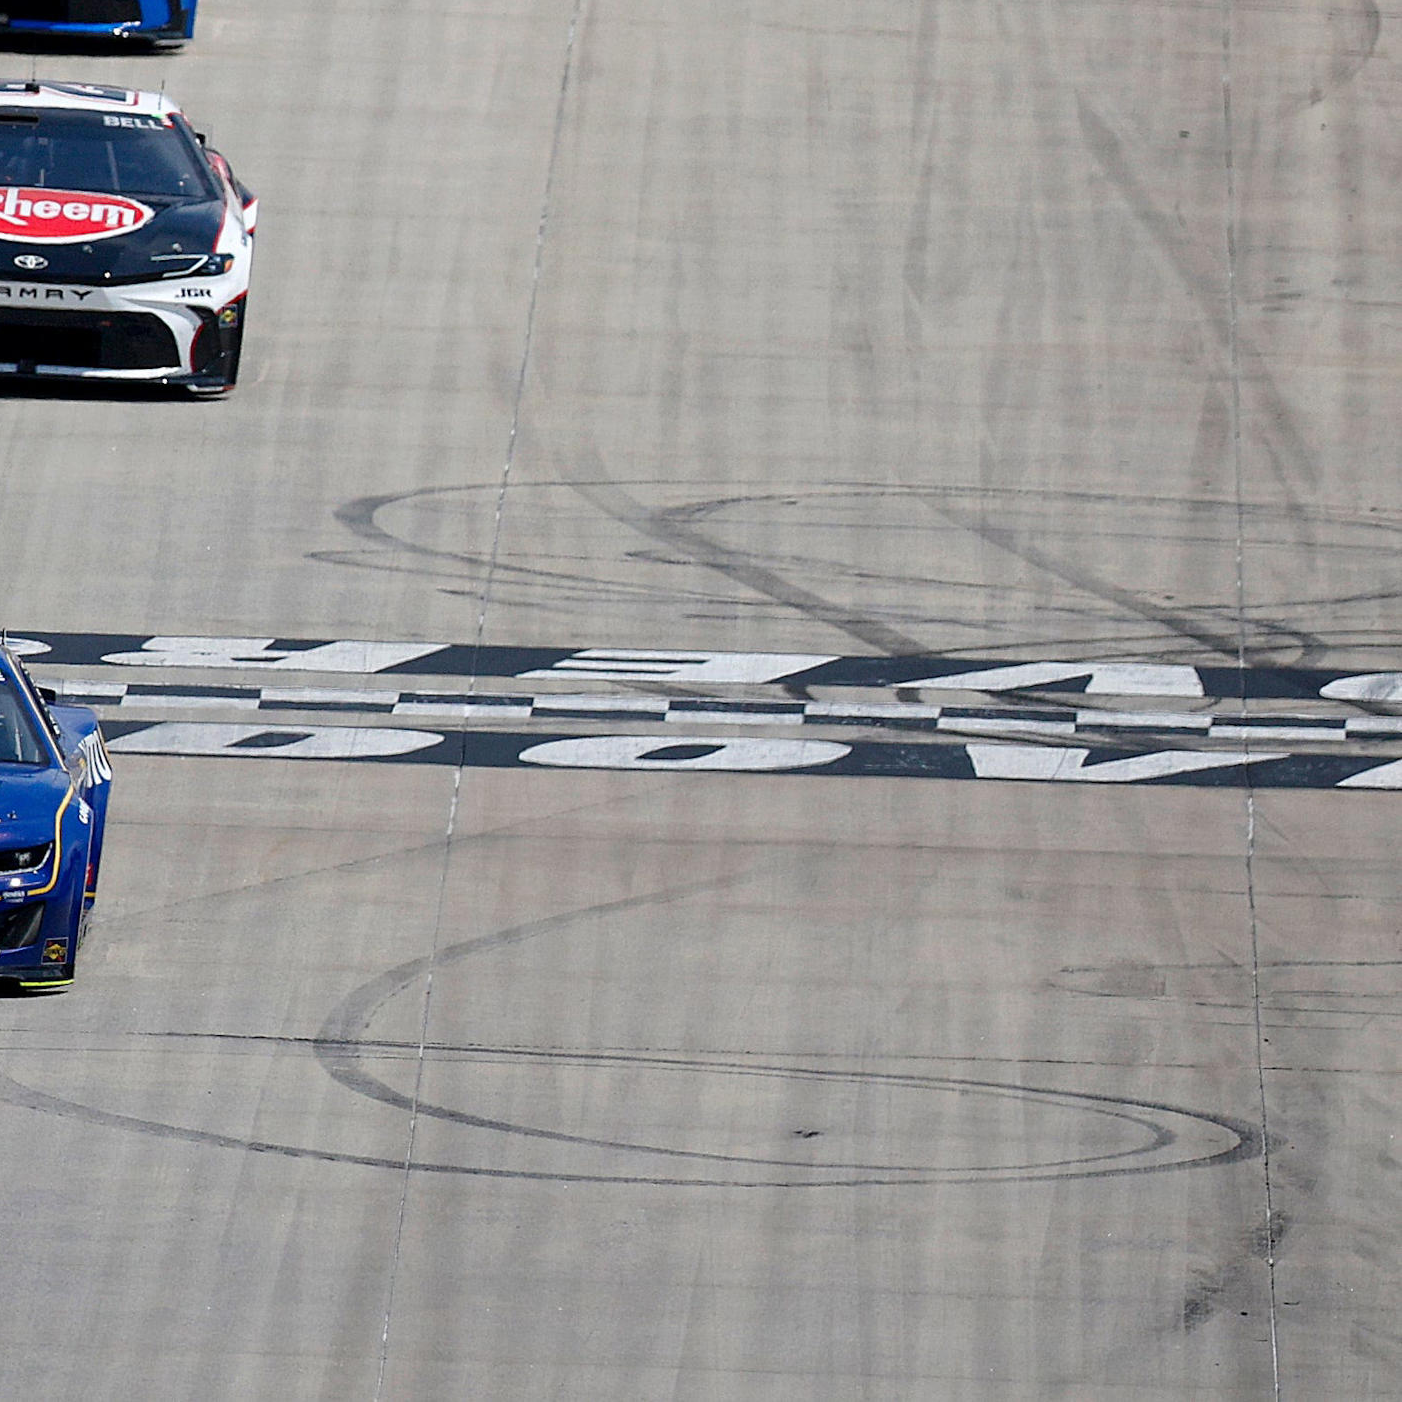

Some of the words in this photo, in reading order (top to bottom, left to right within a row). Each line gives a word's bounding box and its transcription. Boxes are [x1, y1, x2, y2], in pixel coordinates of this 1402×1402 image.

[103, 115, 164, 131] BELL
[175, 287, 213, 299] JGR
[104, 722, 1402, 790] DOV
